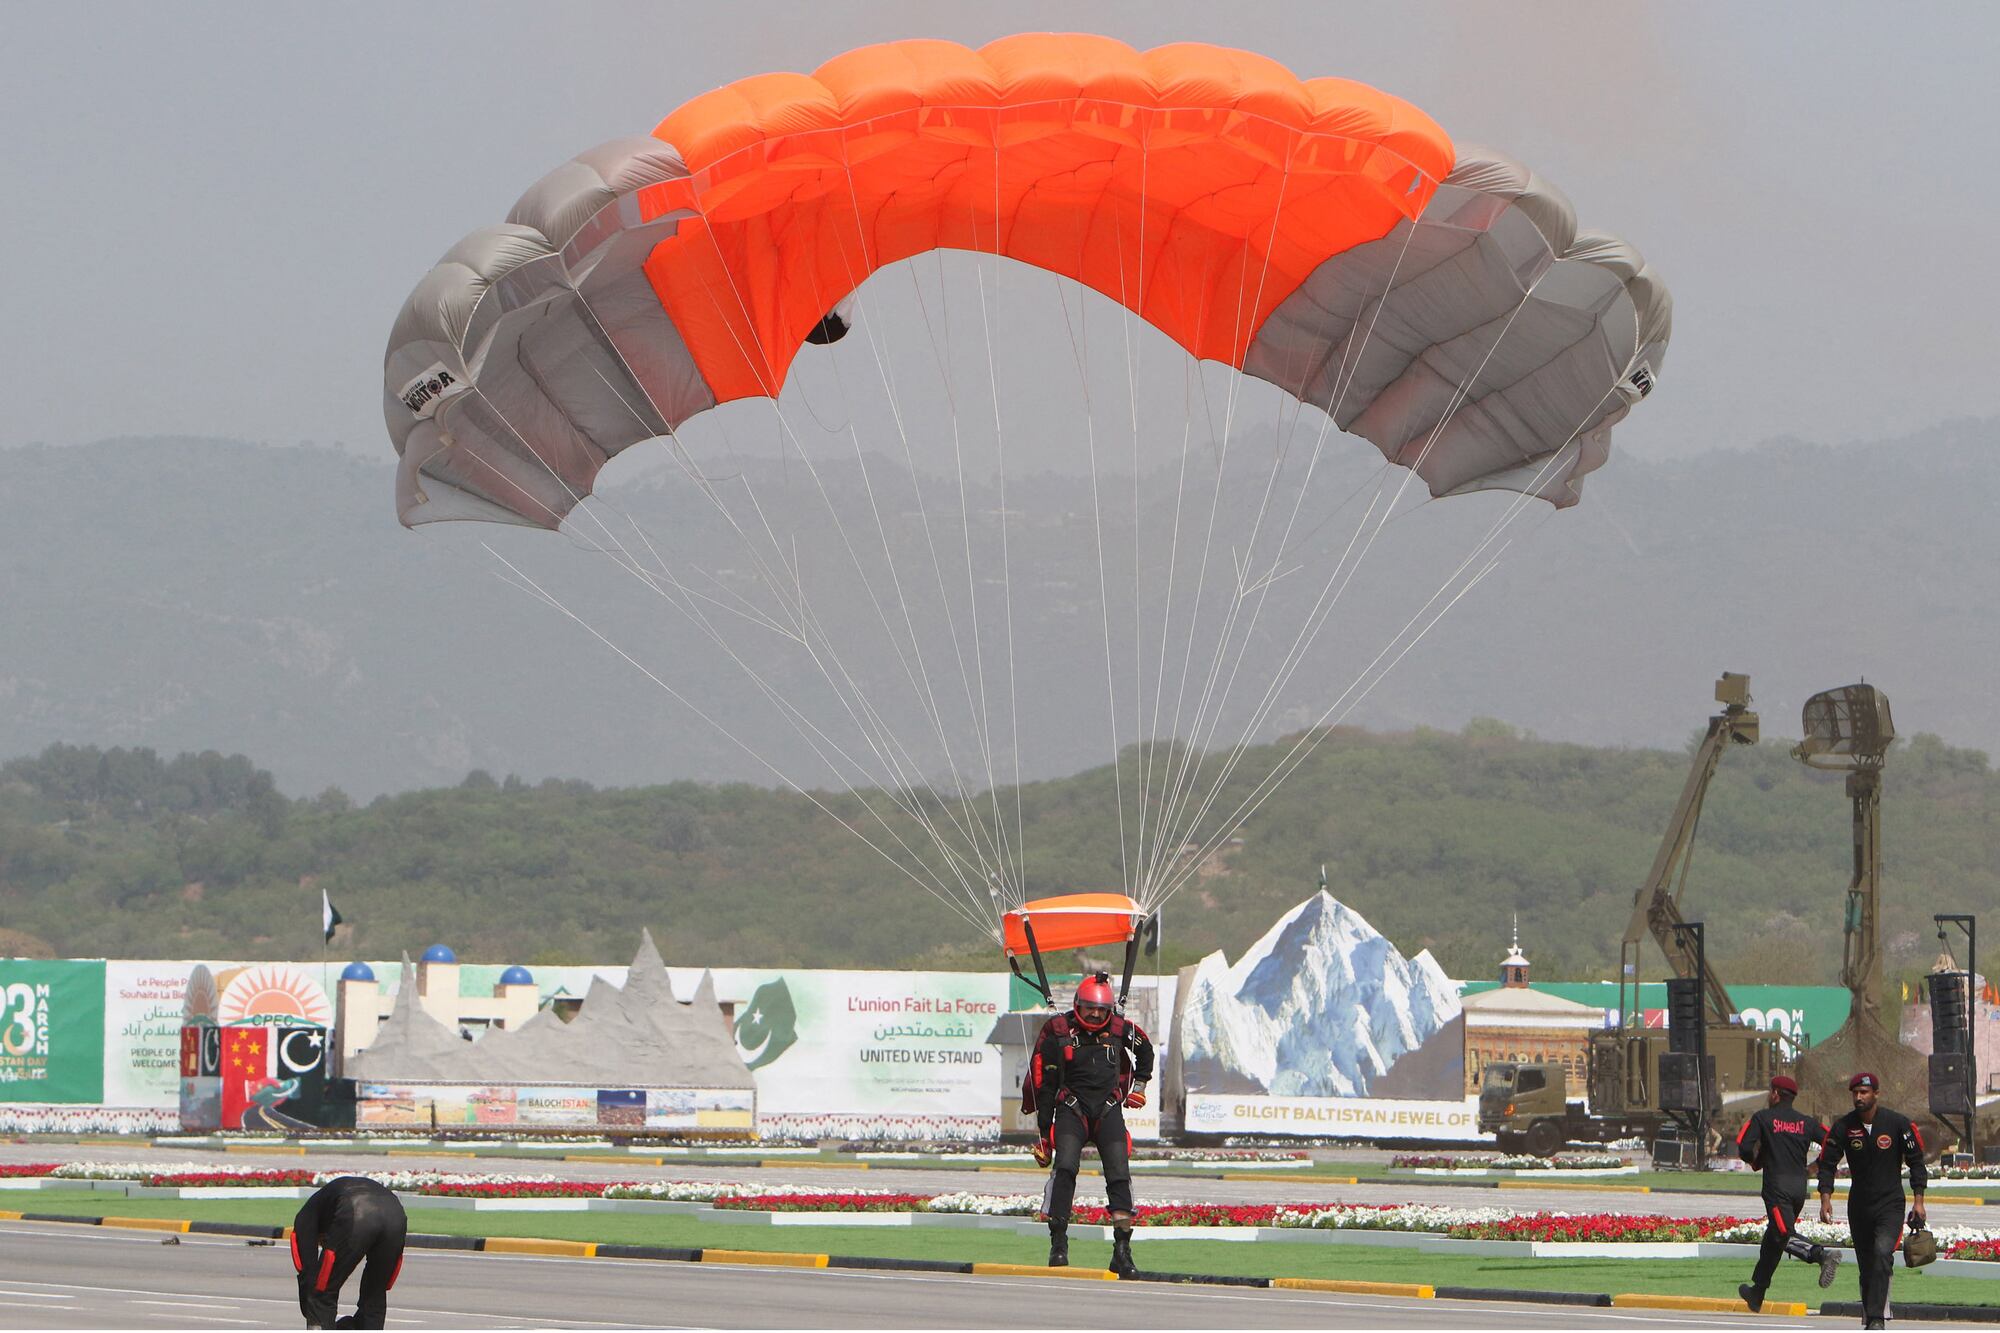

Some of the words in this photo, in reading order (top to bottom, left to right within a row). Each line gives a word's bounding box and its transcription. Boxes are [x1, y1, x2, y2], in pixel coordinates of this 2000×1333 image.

[137, 977, 147, 986] Le
[149, 977, 179, 989] Peuple
[160, 990, 171, 999] La
[905, 997, 932, 1013] Fait
[935, 998, 952, 1014] La
[955, 998, 997, 1014] Force
[36, 984, 49, 1055] MARCH
[252, 1014, 294, 1027] CPEC
[131, 1048, 163, 1057] PEOPLE
[165, 1048, 177, 1057] OF
[860, 1049, 911, 1063] UNITED
[913, 1050, 936, 1063] WE
[938, 1050, 983, 1065] STAND
[132, 1059, 177, 1069] WELCOME
[1233, 1104, 1290, 1119] GILGIT
[1292, 1107, 1387, 1124] BALTISTAN
[1390, 1110, 1445, 1126] JEWEL
[1446, 1112, 1472, 1126] OF
[1773, 1118, 1805, 1135] SHAHBAZ
